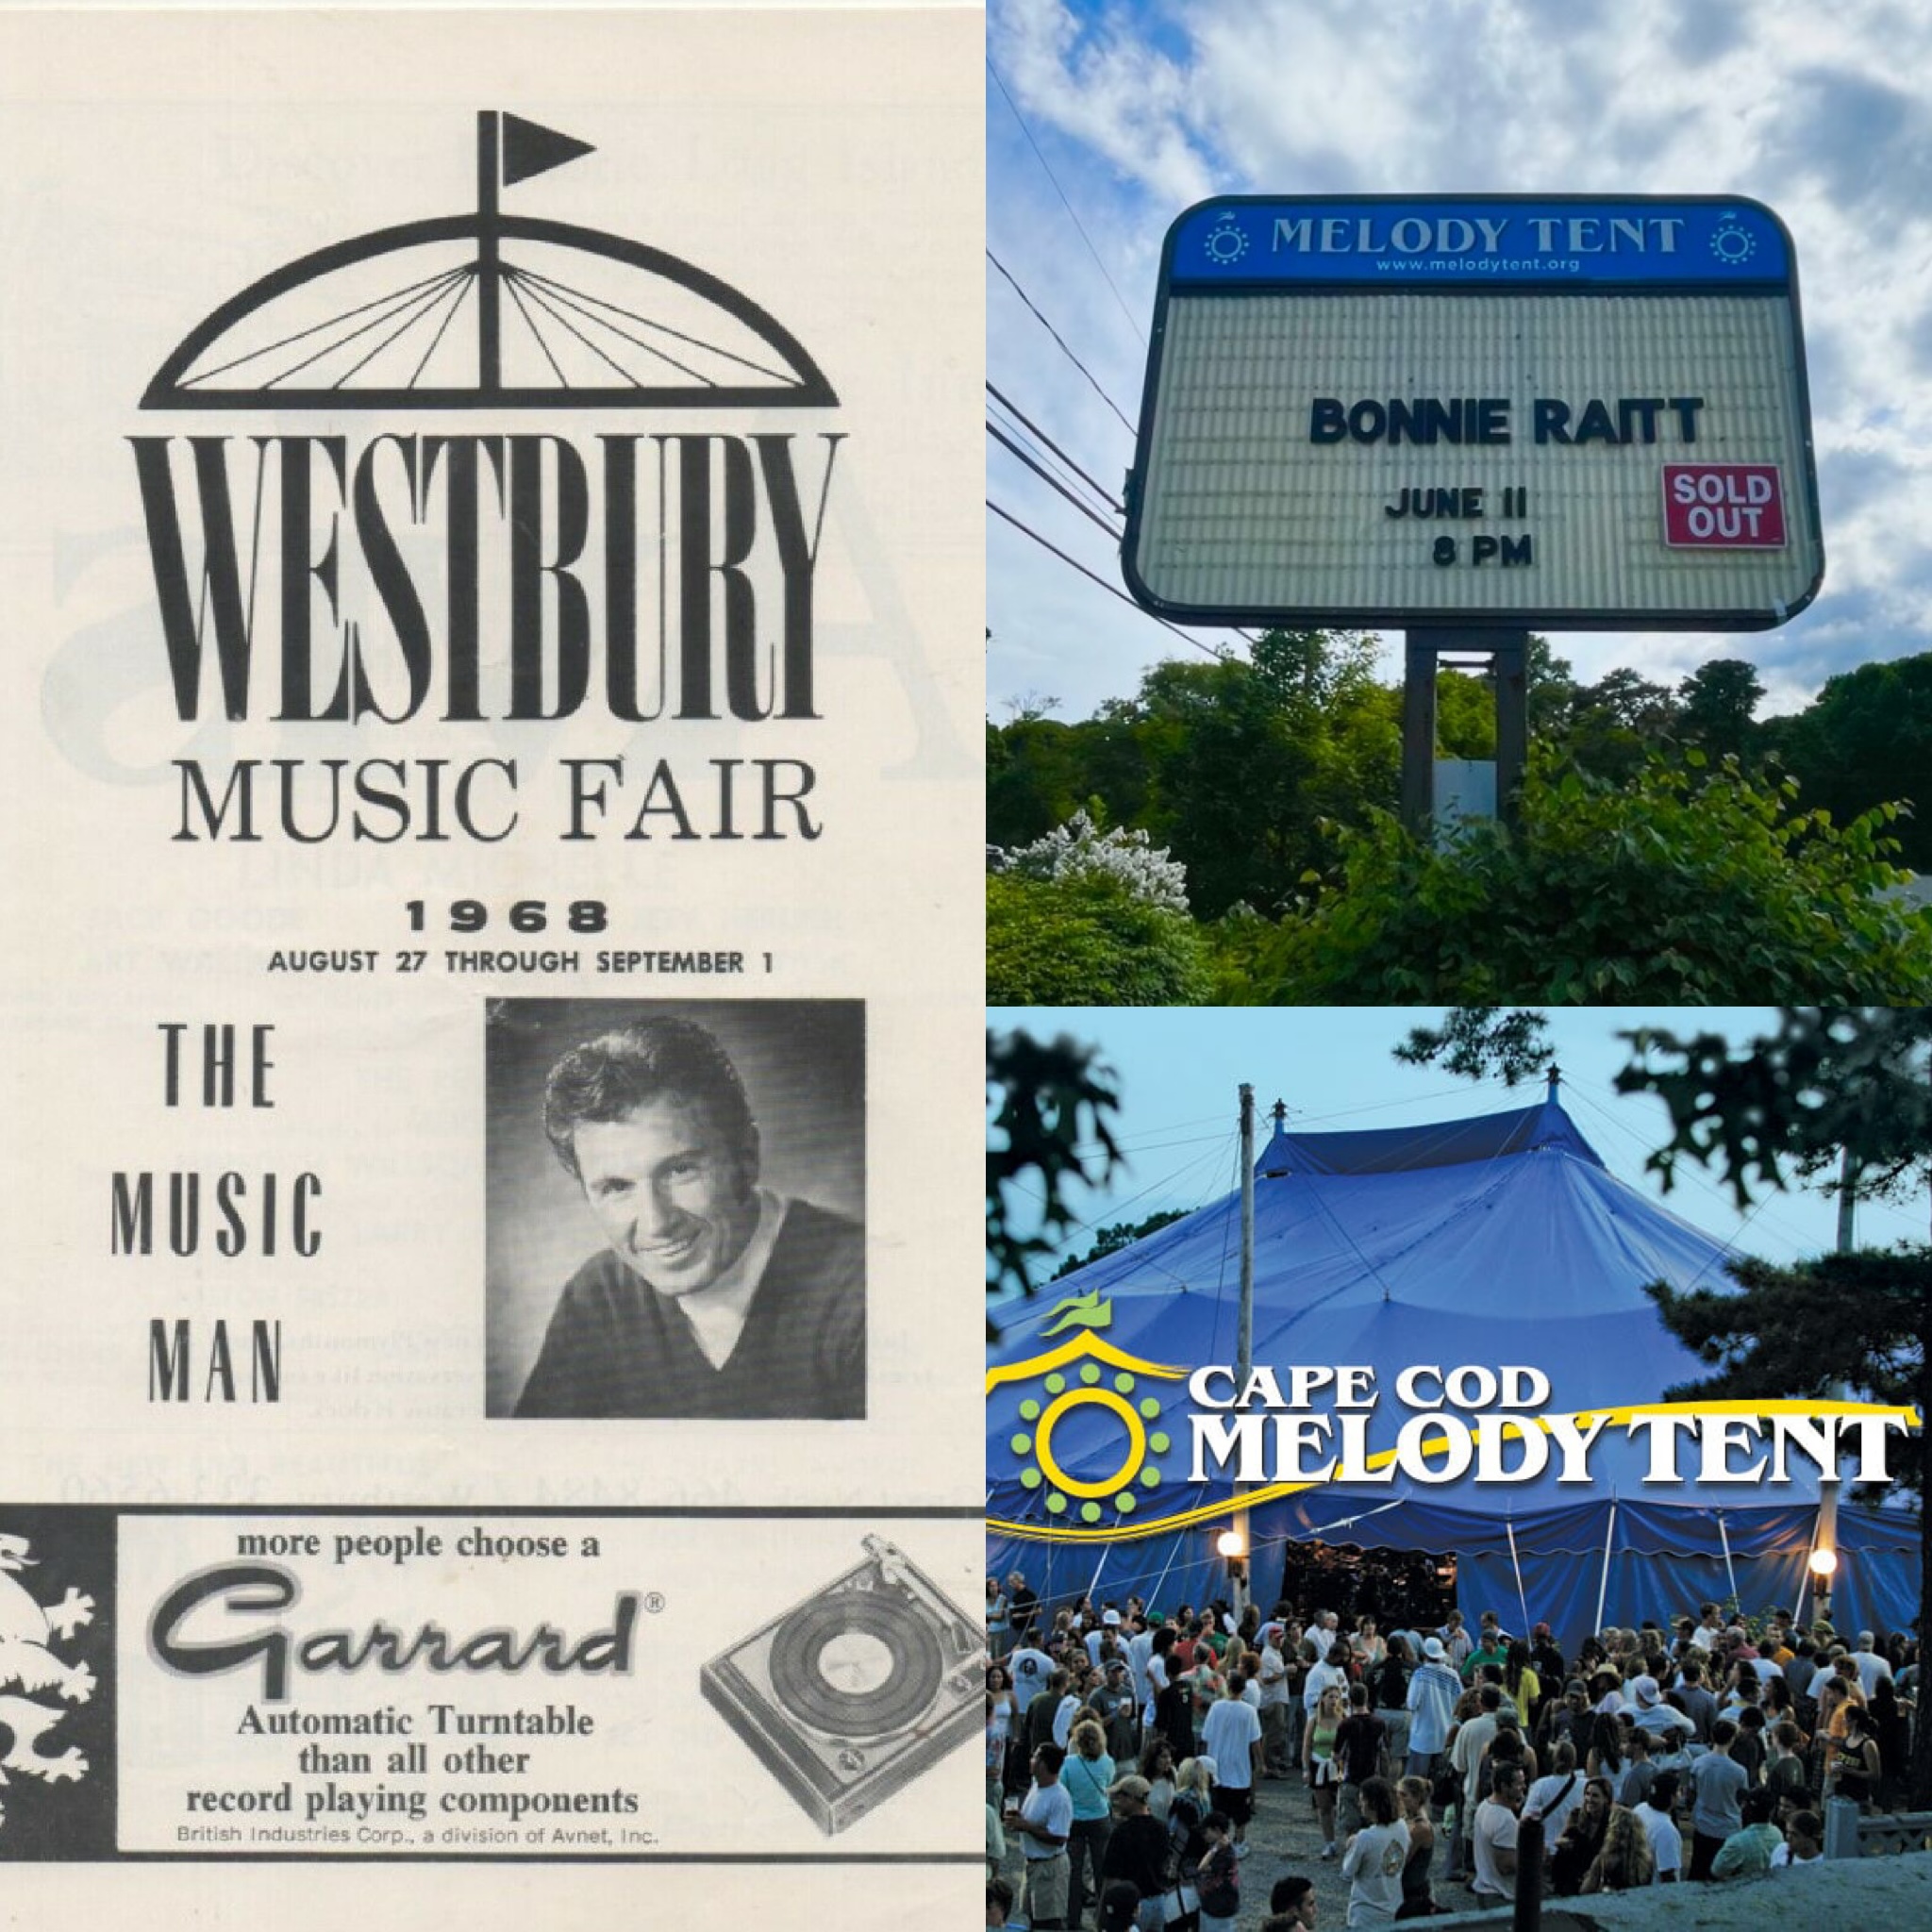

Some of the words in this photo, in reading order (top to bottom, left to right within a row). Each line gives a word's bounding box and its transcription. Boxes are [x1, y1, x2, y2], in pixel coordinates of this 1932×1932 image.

[1272, 218, 1508, 253] MELODY
[1527, 218, 1685, 253] TENT
[1376, 257, 1580, 273] www.melodytent.org
[1309, 397, 1511, 444] BONNIE
[1533, 397, 1705, 444] RAITT
[1384, 487, 1484, 520] JUNE
[1504, 487, 1527, 520] 11
[1673, 474, 1773, 504] SOLD
[1688, 505, 1763, 538] OUT
[1432, 536, 1457, 567] 8
[1472, 535, 1533, 567] PM
[125, 432, 849, 725] WESTBURY
[172, 758, 519, 843] MUSIC
[559, 755, 823, 841] FAIR
[407, 900, 608, 933] 1968
[268, 950, 380, 973] AUGUST
[396, 950, 427, 973] 27
[445, 950, 578, 974] THROUGH
[596, 950, 744, 974] SEPTEMBER
[763, 952, 773, 974] 1
[158, 1024, 275, 1108] THE
[111, 1172, 323, 1257] MUSIC
[149, 1319, 281, 1403] MAN
[238, 1534, 321, 1557] more
[335, 1526, 442, 1561] people
[457, 1526, 567, 1558] choose
[581, 1537, 600, 1557] a
[146, 1560, 643, 1704] Garrard
[238, 1705, 412, 1736] Automatic
[428, 1705, 593, 1736] Turntable
[299, 1744, 371, 1774] than
[387, 1744, 427, 1774] all
[443, 1744, 530, 1774] other
[187, 1782, 291, 1812] record
[306, 1781, 426, 1818] playing
[440, 1787, 639, 1818] components
[177, 1825, 242, 1843] British
[251, 1825, 351, 1843] Industries
[357, 1825, 416, 1846] Corp.,
[423, 1831, 435, 1843] a
[441, 1825, 519, 1843] division
[525, 1825, 546, 1843] of
[551, 1825, 613, 1846] Avnet,
[621, 1825, 659, 1844] Inc.
